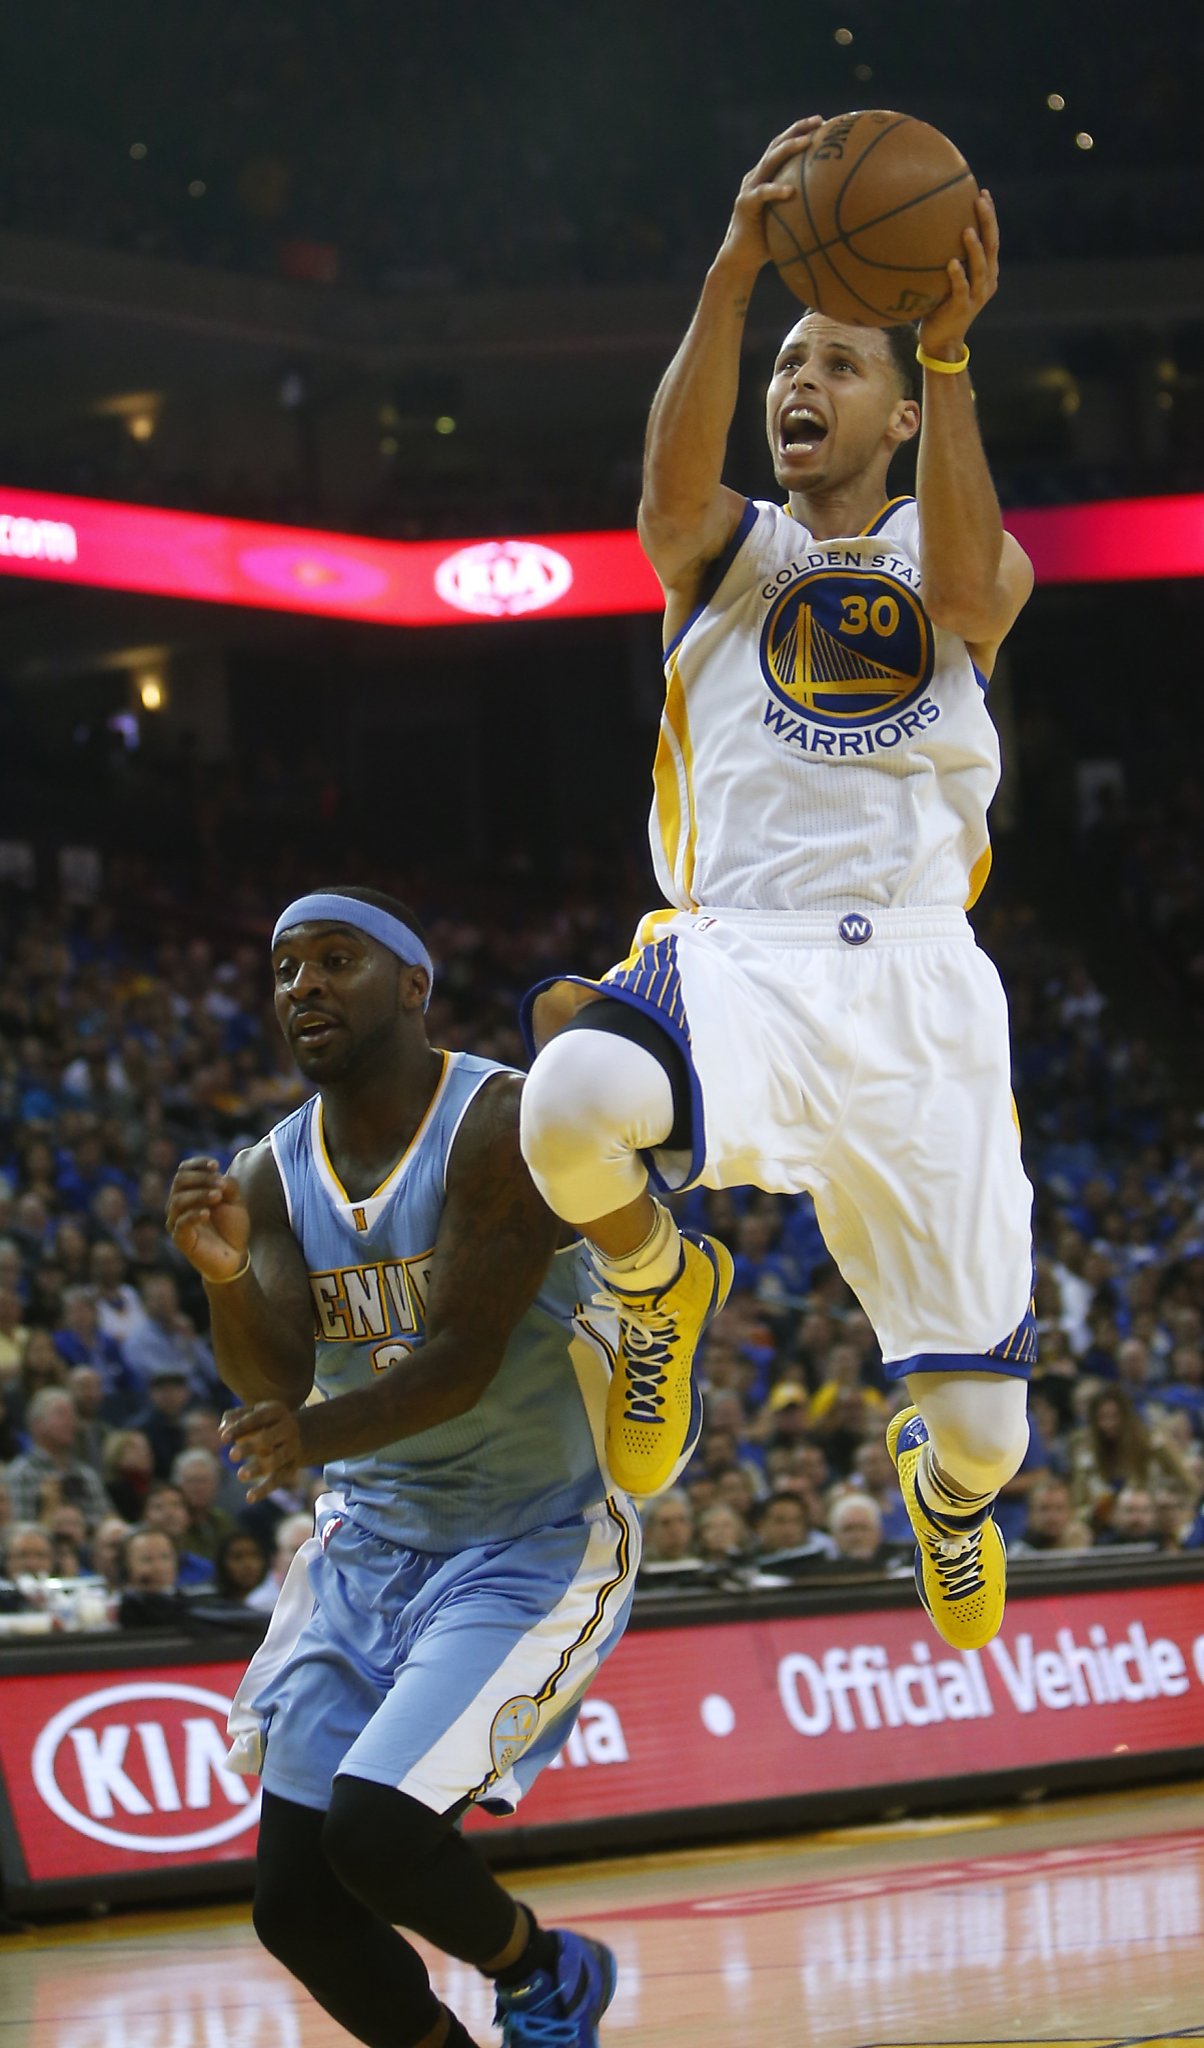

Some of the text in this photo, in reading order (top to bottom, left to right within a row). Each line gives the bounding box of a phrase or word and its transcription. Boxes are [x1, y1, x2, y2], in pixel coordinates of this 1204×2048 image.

[762, 551, 862, 600] GOLDEN
[838, 595, 900, 637] 30
[762, 696, 942, 757] WARRIORS
[352, 1207, 368, 1232] N
[777, 1640, 994, 1737] Official
[987, 1619, 1190, 1713] Vehicle
[68, 1717, 252, 1819] KIA
